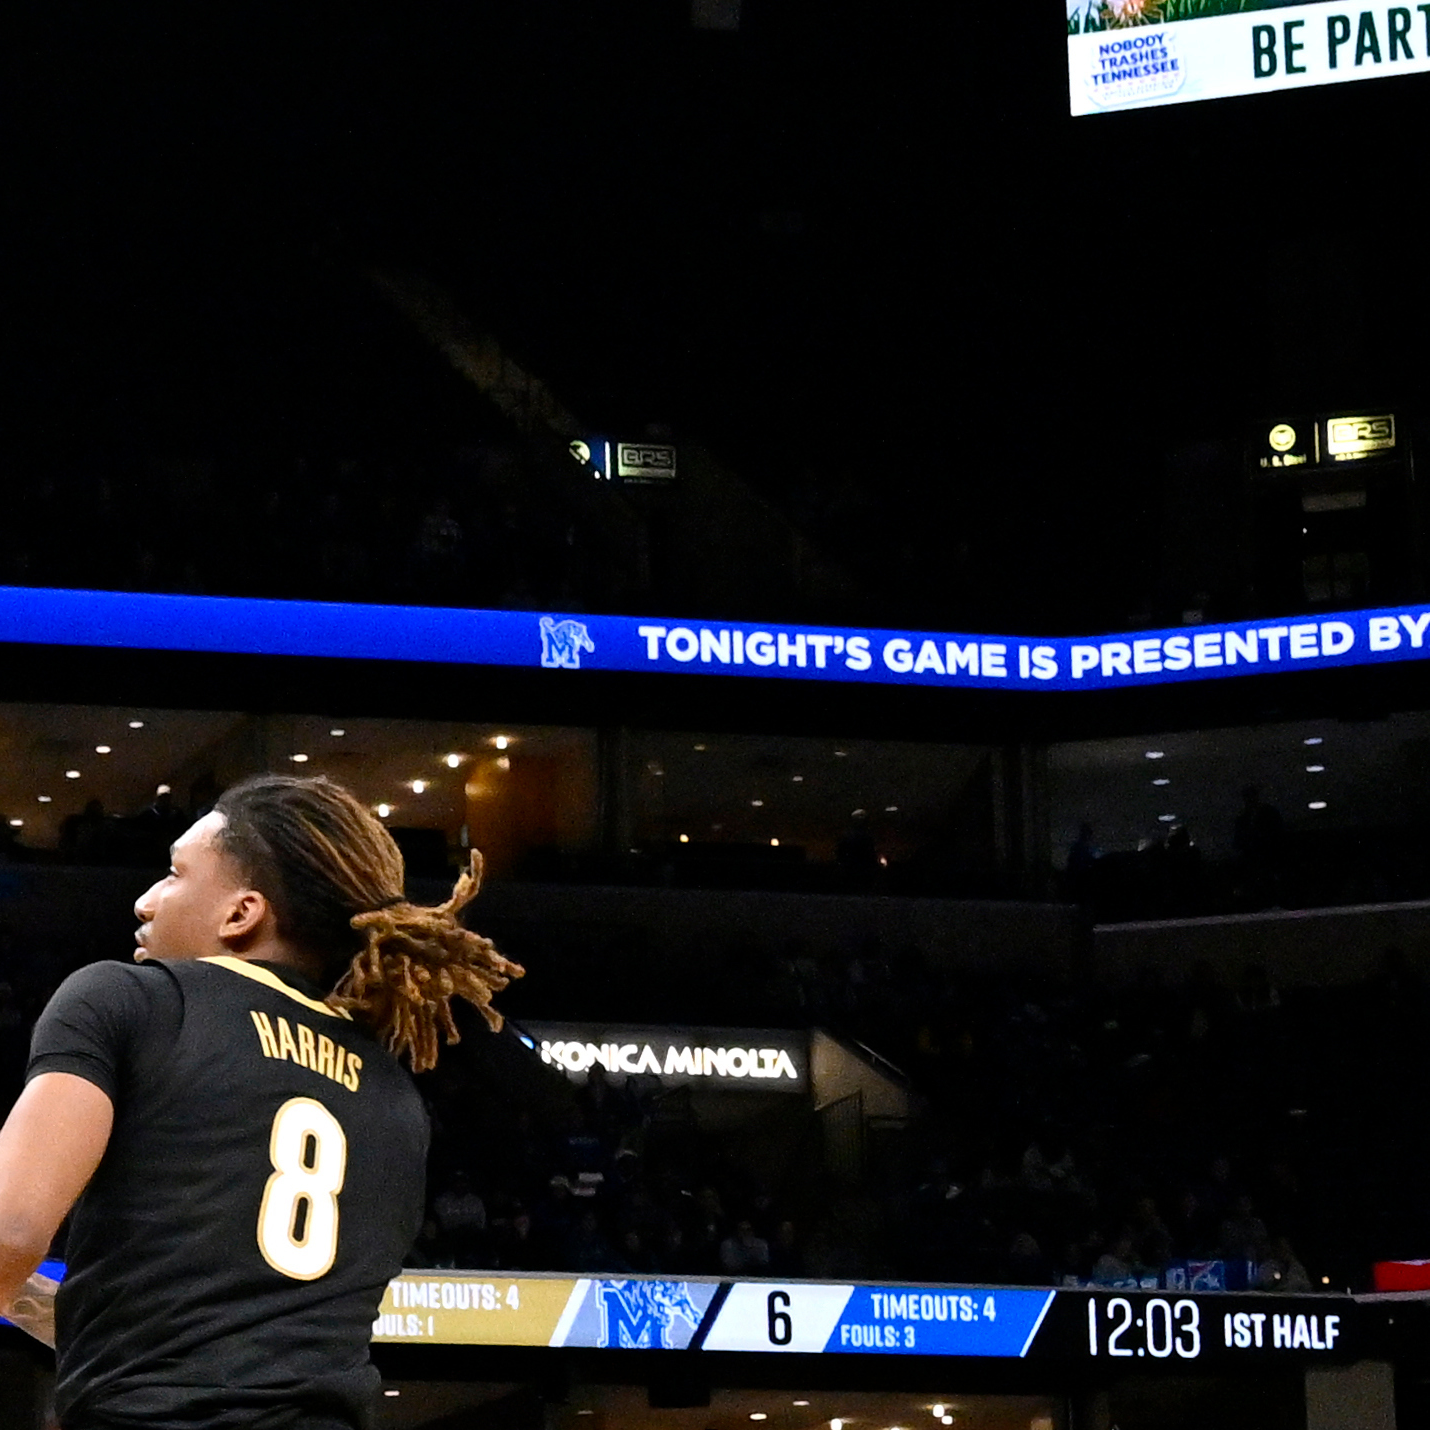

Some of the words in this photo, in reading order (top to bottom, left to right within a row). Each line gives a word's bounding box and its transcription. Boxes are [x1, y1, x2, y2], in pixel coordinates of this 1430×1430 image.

[1099, 32, 1164, 57] NOBODY
[1099, 47, 1168, 71] TRASHES
[1252, 20, 1306, 78] BE
[1091, 58, 1180, 86] TENNESSEE
[638, 625, 873, 671] TONIGHT'S
[883, 639, 1008, 679] GAME
[1019, 644, 1058, 679] IS
[1071, 625, 1355, 679] PRESENTED
[1369, 611, 1430, 652] BY
[250, 1010, 363, 1093] HARRIS
[664, 1045, 798, 1079] MINOLTA
[256, 1097, 348, 1281] 8
[390, 1281, 502, 1310] TIMEOUTS:
[506, 1284, 520, 1310] 4
[870, 1293, 979, 1322] TIMEOUTS:
[983, 1296, 996, 1322] 4
[371, 1313, 424, 1336] OULS:
[767, 1290, 793, 1346] 6
[1088, 1297, 1201, 1358] 12:03
[1272, 1313, 1340, 1350] HALF
[840, 1324, 901, 1347] FOULS:
[905, 1326, 916, 1348] 3
